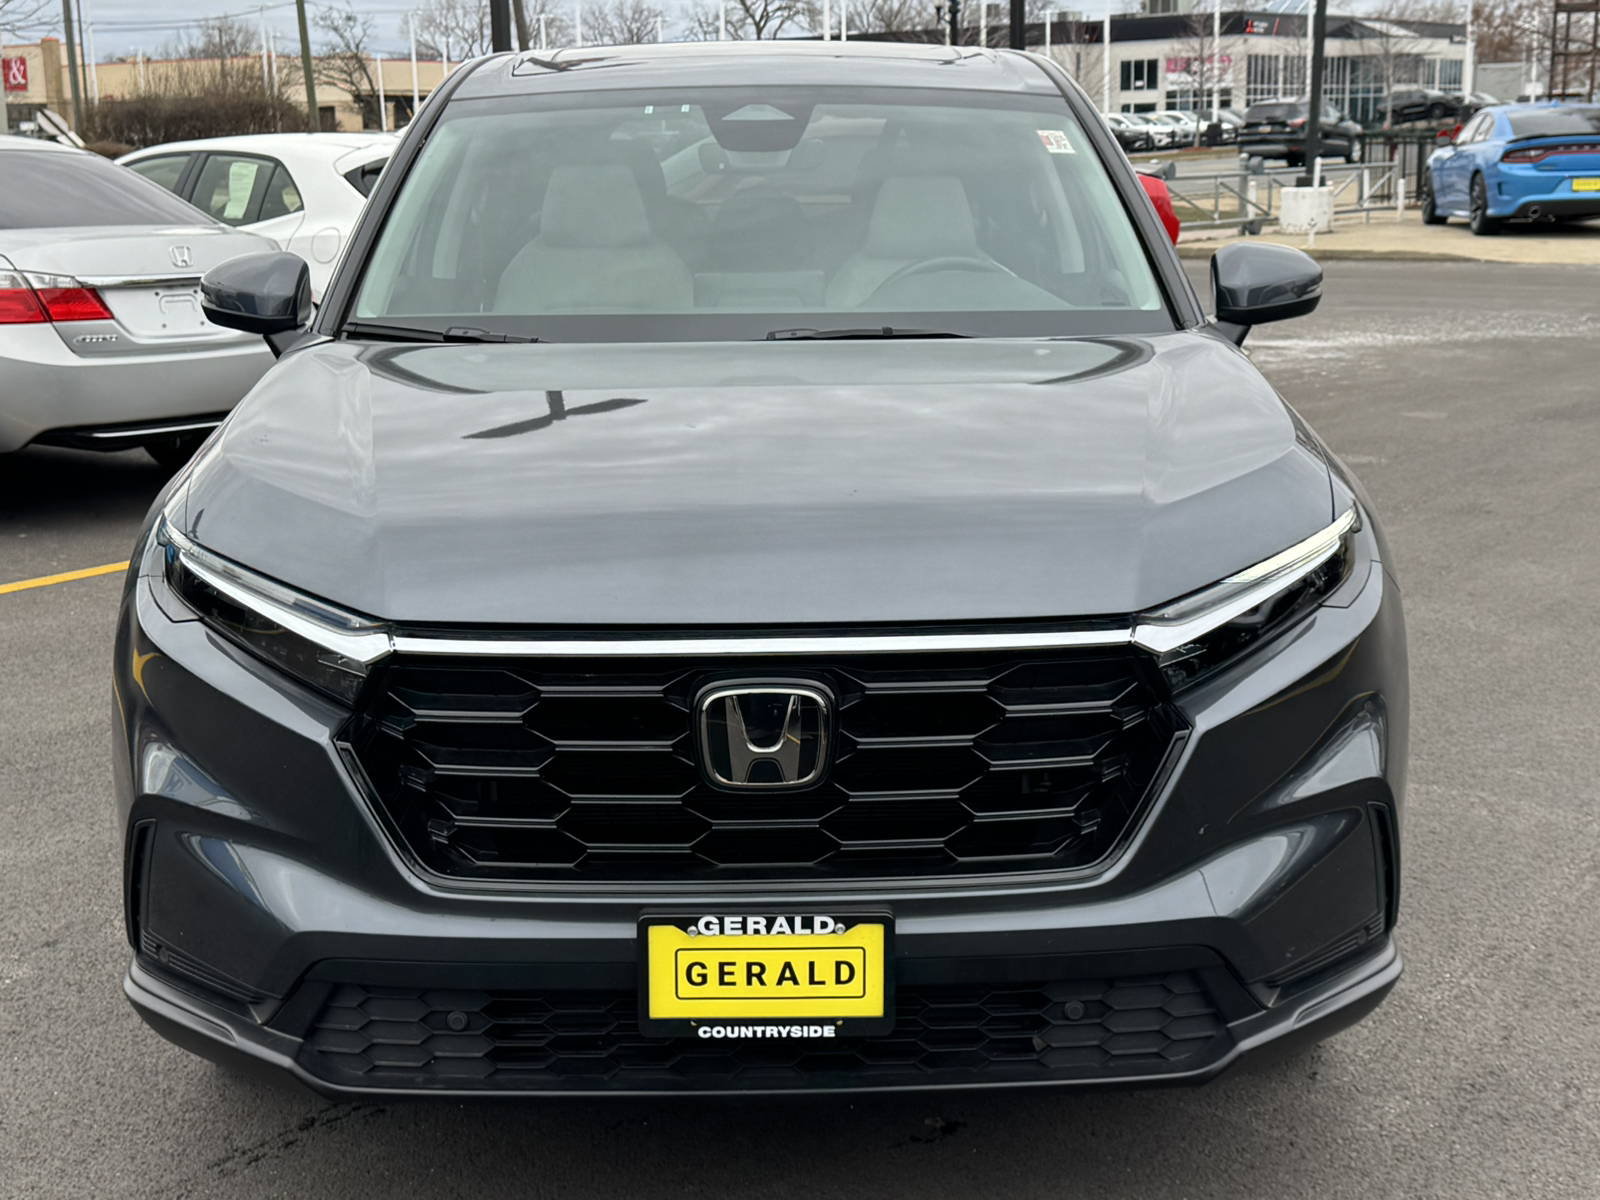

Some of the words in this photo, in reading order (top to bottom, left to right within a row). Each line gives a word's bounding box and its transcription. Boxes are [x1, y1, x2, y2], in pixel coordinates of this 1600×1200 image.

[697, 915, 835, 936] GERALD
[685, 960, 856, 987] GERALD
[697, 1025, 836, 1039] COUNTRYSIDE
